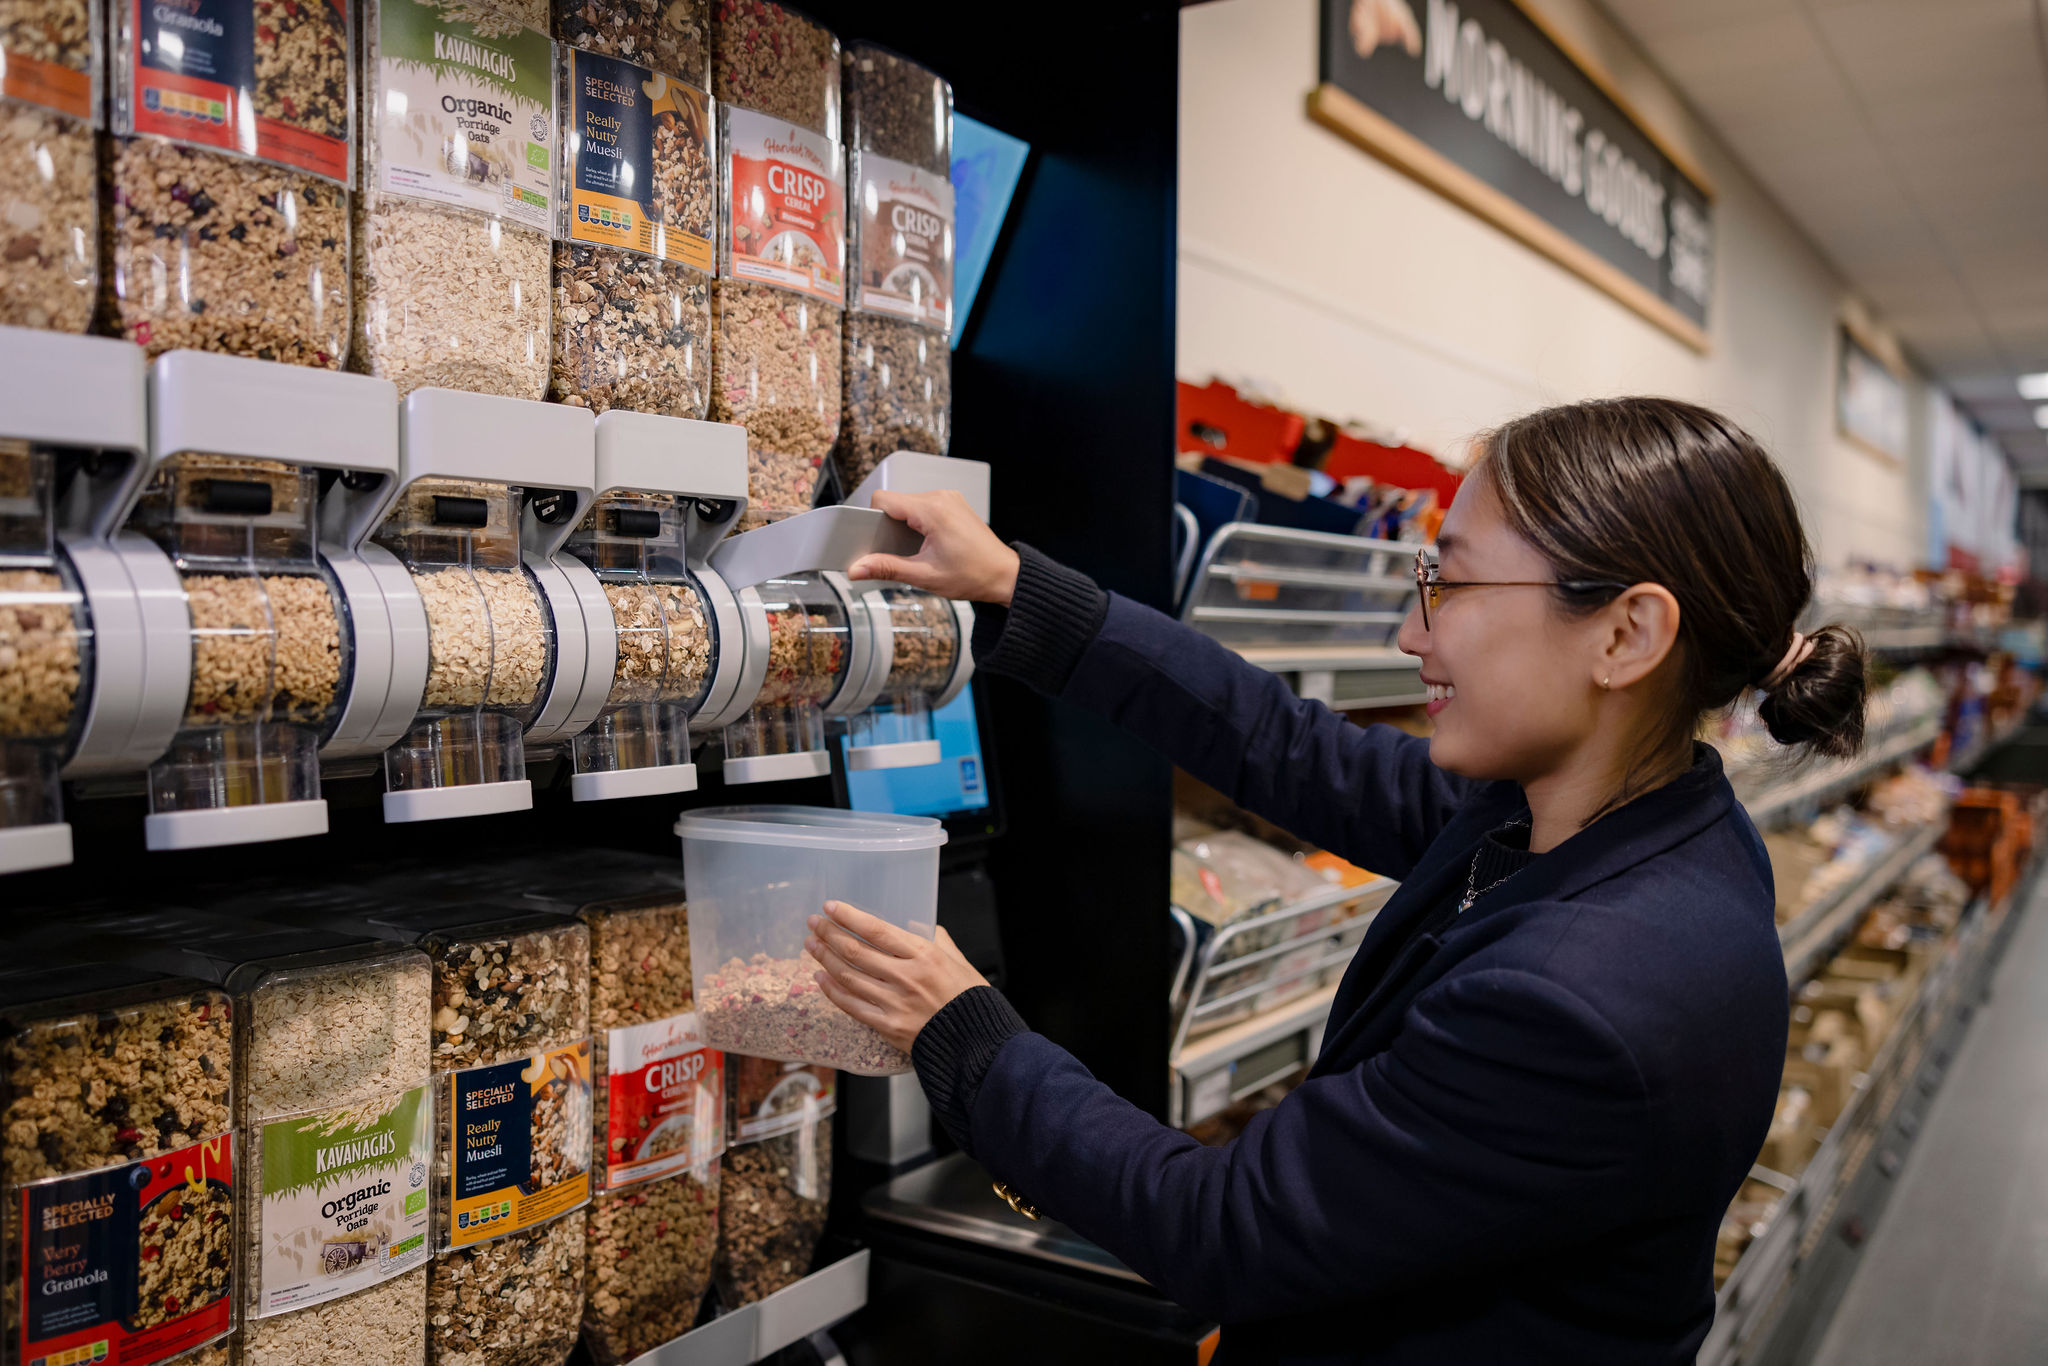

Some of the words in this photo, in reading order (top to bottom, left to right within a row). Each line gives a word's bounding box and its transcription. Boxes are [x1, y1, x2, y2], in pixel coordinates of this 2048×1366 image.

[153, 5, 224, 37] Granola
[434, 31, 516, 83] KAVANAGH'S
[585, 76, 636, 98] SPECIALLY
[585, 86, 635, 107] SELECTED
[441, 95, 512, 125] Organic
[457, 117, 501, 136] Porridge
[586, 111, 621, 132] Really
[1424, 0, 1585, 196] MORNING
[1584, 129, 1666, 259] GOODS
[467, 129, 491, 145] Oats
[586, 126, 618, 147] Nutty
[586, 142, 622, 160] Muesli
[767, 165, 825, 206] CRISP
[891, 205, 940, 240] CRISP
[645, 1053, 705, 1093] CRISP
[466, 1083, 516, 1101] SPECIALLY
[466, 1093, 514, 1111] SELECTED
[466, 1119, 502, 1136] Really
[316, 1128, 396, 1174] KAVANAGH'S
[466, 1134, 498, 1150] Nutty
[466, 1144, 502, 1163] Muesli
[42, 1193, 116, 1220] SPECIALLY
[321, 1178, 391, 1220] Organic
[43, 1206, 114, 1231] SELECTED
[336, 1202, 379, 1227] Porridge
[346, 1217, 368, 1233] Oats
[42, 1243, 80, 1263] Very
[43, 1259, 87, 1280] Berry
[42, 1269, 109, 1296] Granola
